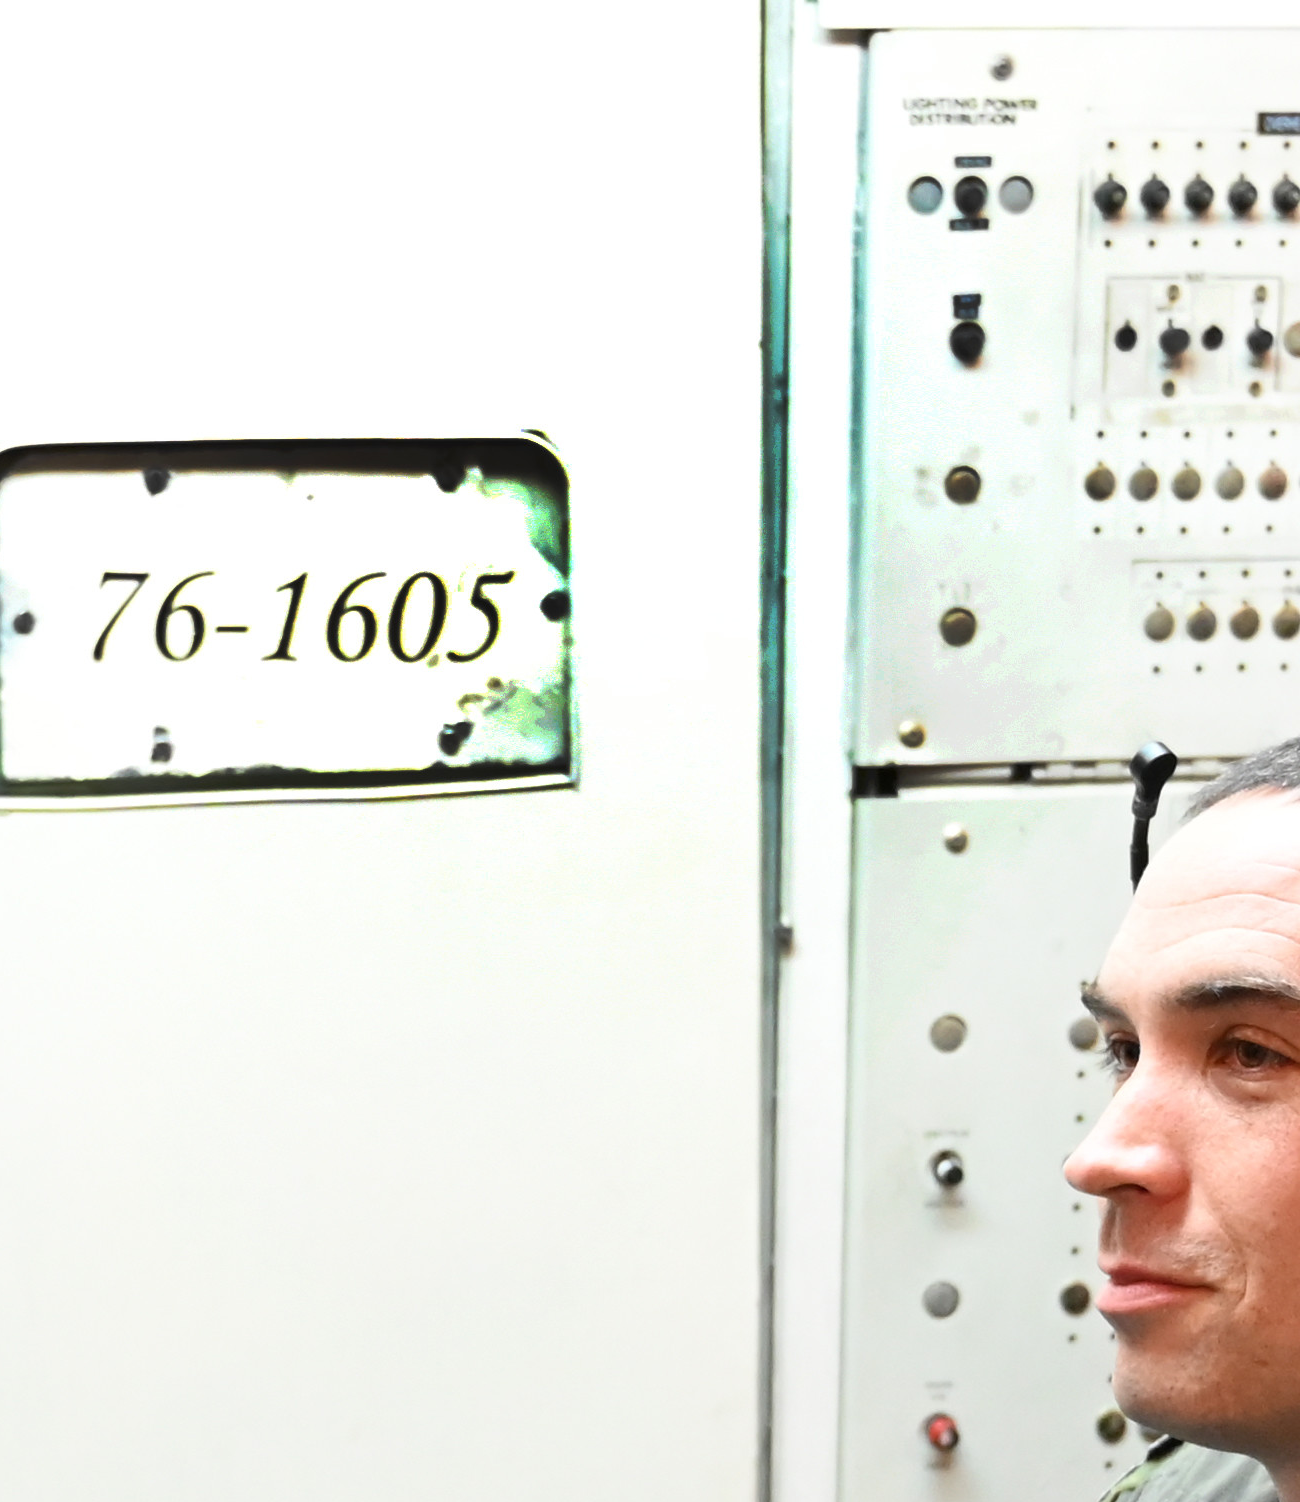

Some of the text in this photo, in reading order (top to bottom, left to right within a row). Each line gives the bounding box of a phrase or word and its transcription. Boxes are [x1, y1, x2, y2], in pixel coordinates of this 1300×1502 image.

[903, 98, 978, 111] LIGHTING
[909, 114, 1016, 126] DISTRIBUTION
[92, 570, 515, 664] 76-1605
